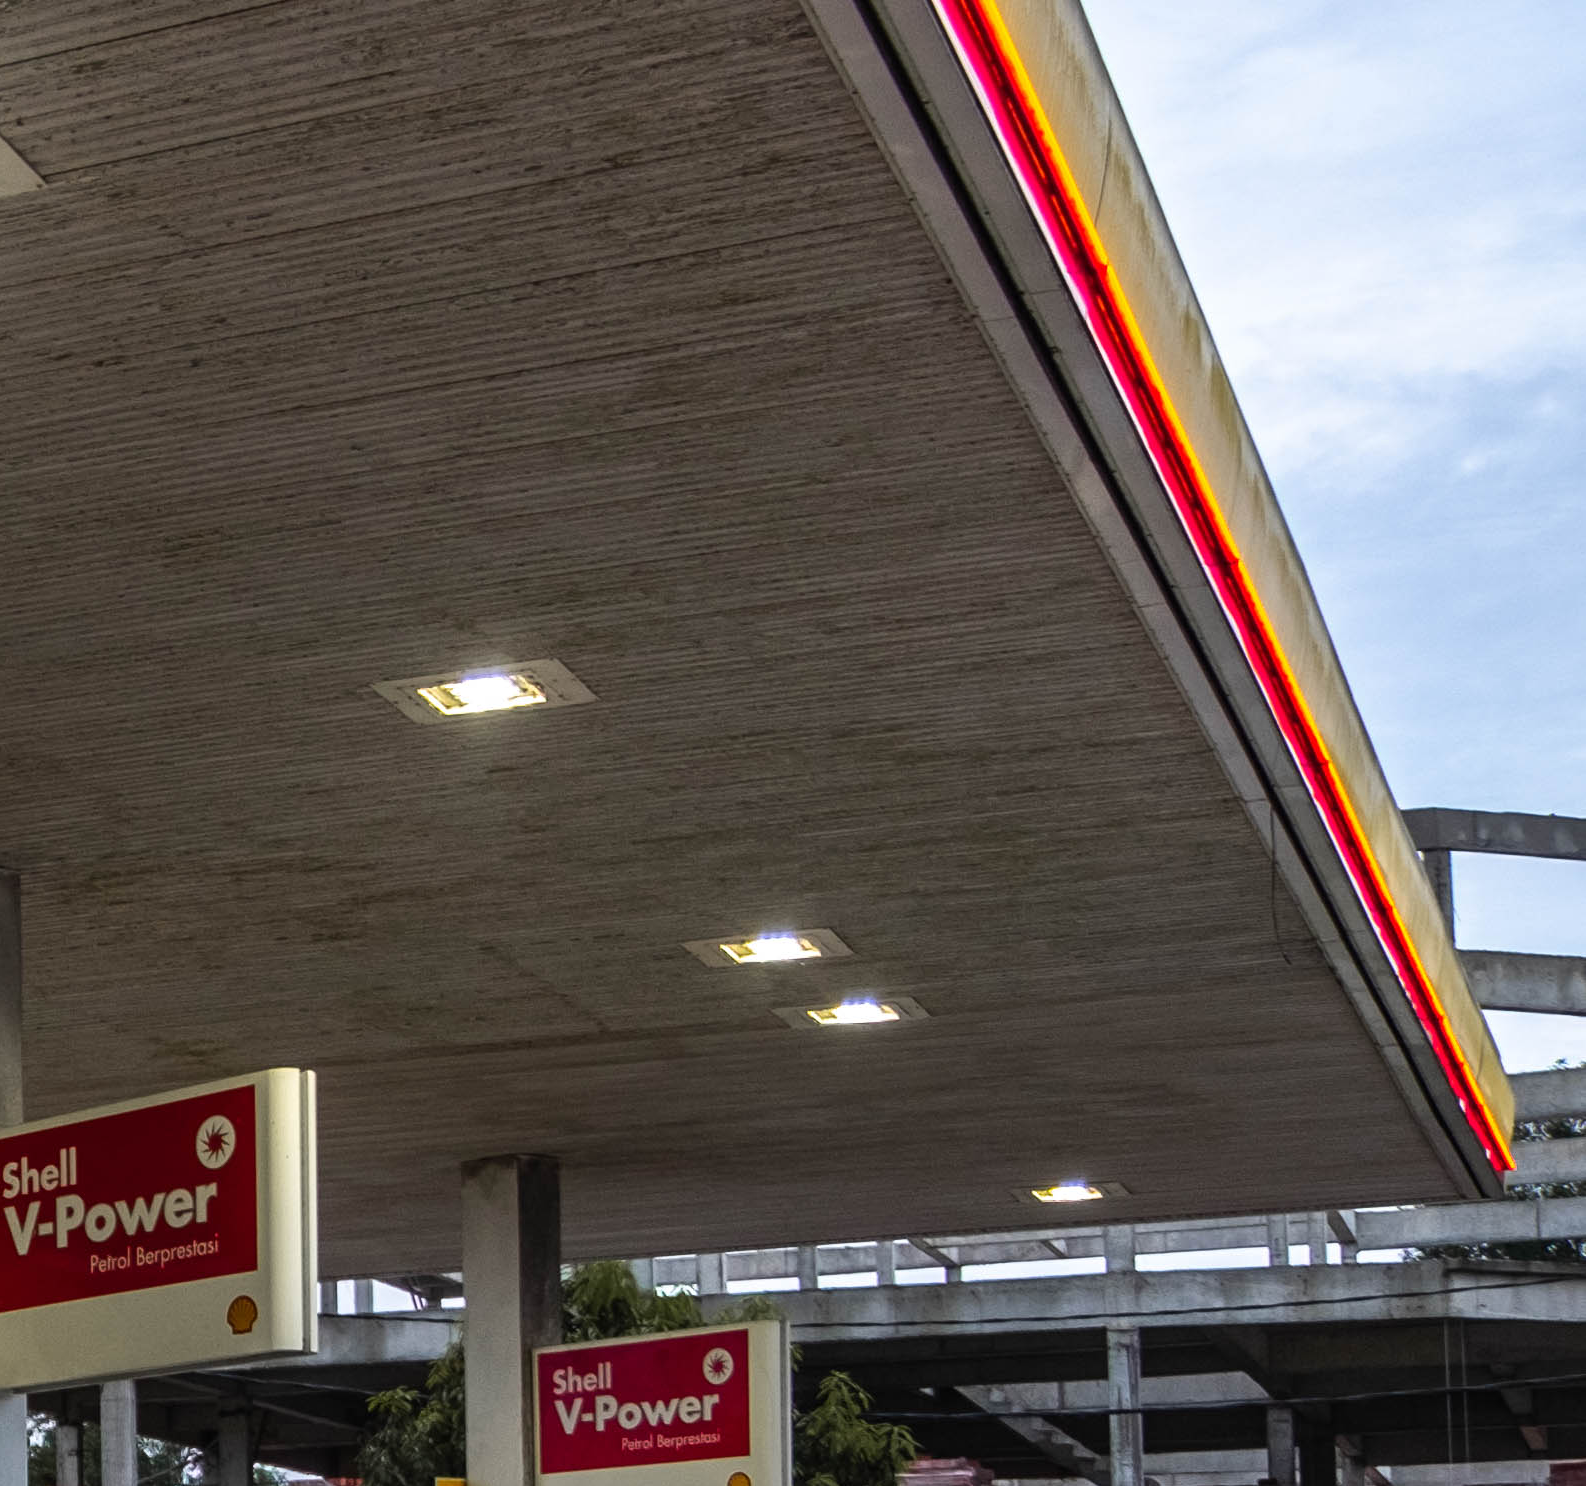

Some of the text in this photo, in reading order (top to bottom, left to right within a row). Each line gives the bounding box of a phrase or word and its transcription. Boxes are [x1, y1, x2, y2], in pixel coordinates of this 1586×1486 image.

[2, 1147, 77, 1200] Shell
[3, 1181, 218, 1256] V-Power
[90, 1233, 219, 1274] Petrol Berprestasi
[552, 1362, 611, 1395] Shell
[554, 1392, 720, 1435] V-Power
[621, 1429, 721, 1450] Petrol Berprestasi
